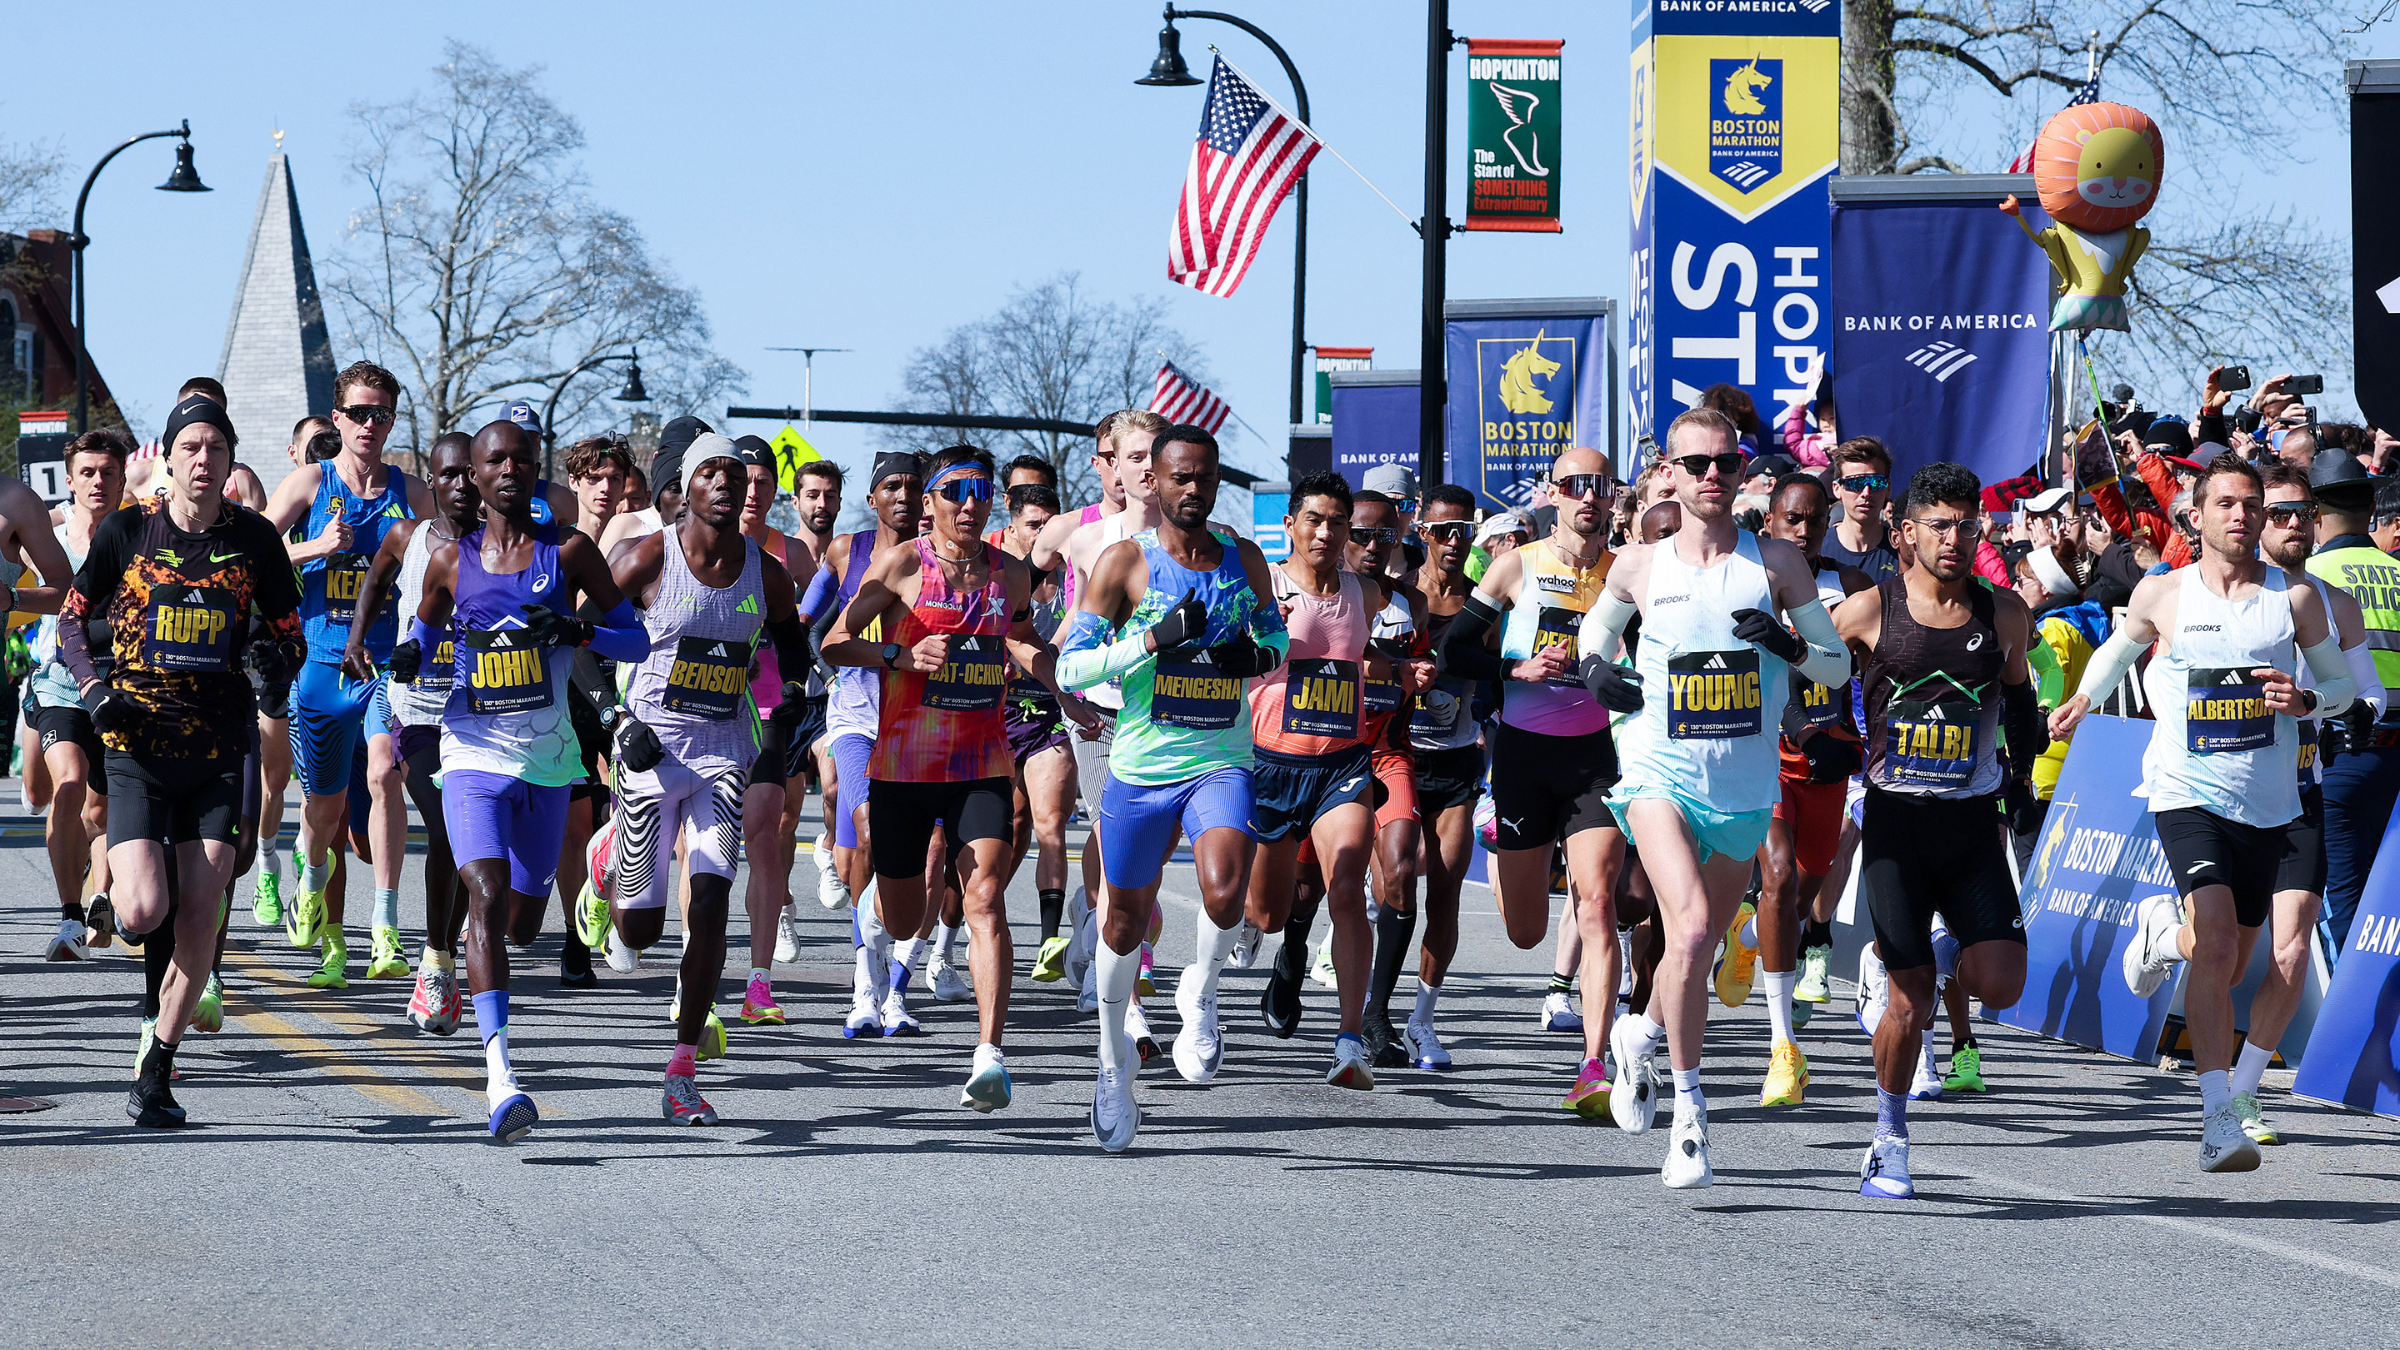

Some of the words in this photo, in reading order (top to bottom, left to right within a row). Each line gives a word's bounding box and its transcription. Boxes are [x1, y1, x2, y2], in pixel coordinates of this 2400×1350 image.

[1660, 1, 1702, 12] BANK
[1705, 1, 1724, 12] OF
[1727, 1, 1797, 13] AMERICA
[1469, 58, 1560, 81] HOPKINTON
[1712, 120, 1780, 134] BOSTON
[1712, 136, 1780, 146] MARATHON
[1474, 149, 1495, 163] The
[1474, 164, 1503, 179] Start
[1503, 164, 1515, 178] of
[1474, 179, 1548, 197] SOMETHING
[1474, 196, 1548, 213] Extraordinary
[1844, 315, 1903, 331] BANK
[1908, 315, 1935, 330] OF
[1940, 313, 2038, 330] AMERICA
[1485, 421, 1572, 441] BOSTON
[1485, 443, 1573, 457] MARATHON
[1340, 453, 1377, 464] BANK
[1379, 453, 1397, 463] OF
[1486, 463, 1513, 471] BANK
[1515, 463, 1527, 471] OF
[42, 467, 56, 495] 1
[1536, 575, 1576, 588] wahoo
[2341, 564, 2400, 586] STATE
[925, 600, 963, 611] MONGOLIA
[1654, 594, 1691, 607] BROOKS
[2339, 585, 2400, 611] OLIC
[155, 604, 226, 645] RUPP
[2184, 625, 2222, 633] BROOKS
[471, 647, 543, 689] JOHN
[668, 659, 747, 695] BENSON
[1154, 673, 1241, 700] MENGESHA
[1669, 671, 1761, 712] YOUNG
[495, 698, 516, 706] BOSTON
[516, 694, 545, 704] MARATHON
[1292, 676, 1355, 714] JAMI
[1815, 713, 1838, 721] MARATHON
[1329, 723, 1352, 731] MARATHON
[1724, 721, 1753, 729] MARATHON
[1894, 722, 1972, 762] TALBI
[2241, 732, 2266, 742] MARATHON
[1917, 770, 1938, 778] BOSTON
[2062, 827, 2127, 876] BOSTON
[2047, 887, 2079, 915] BANK
[2073, 892, 2093, 917] OF
[2087, 896, 2138, 928] AMERICA
